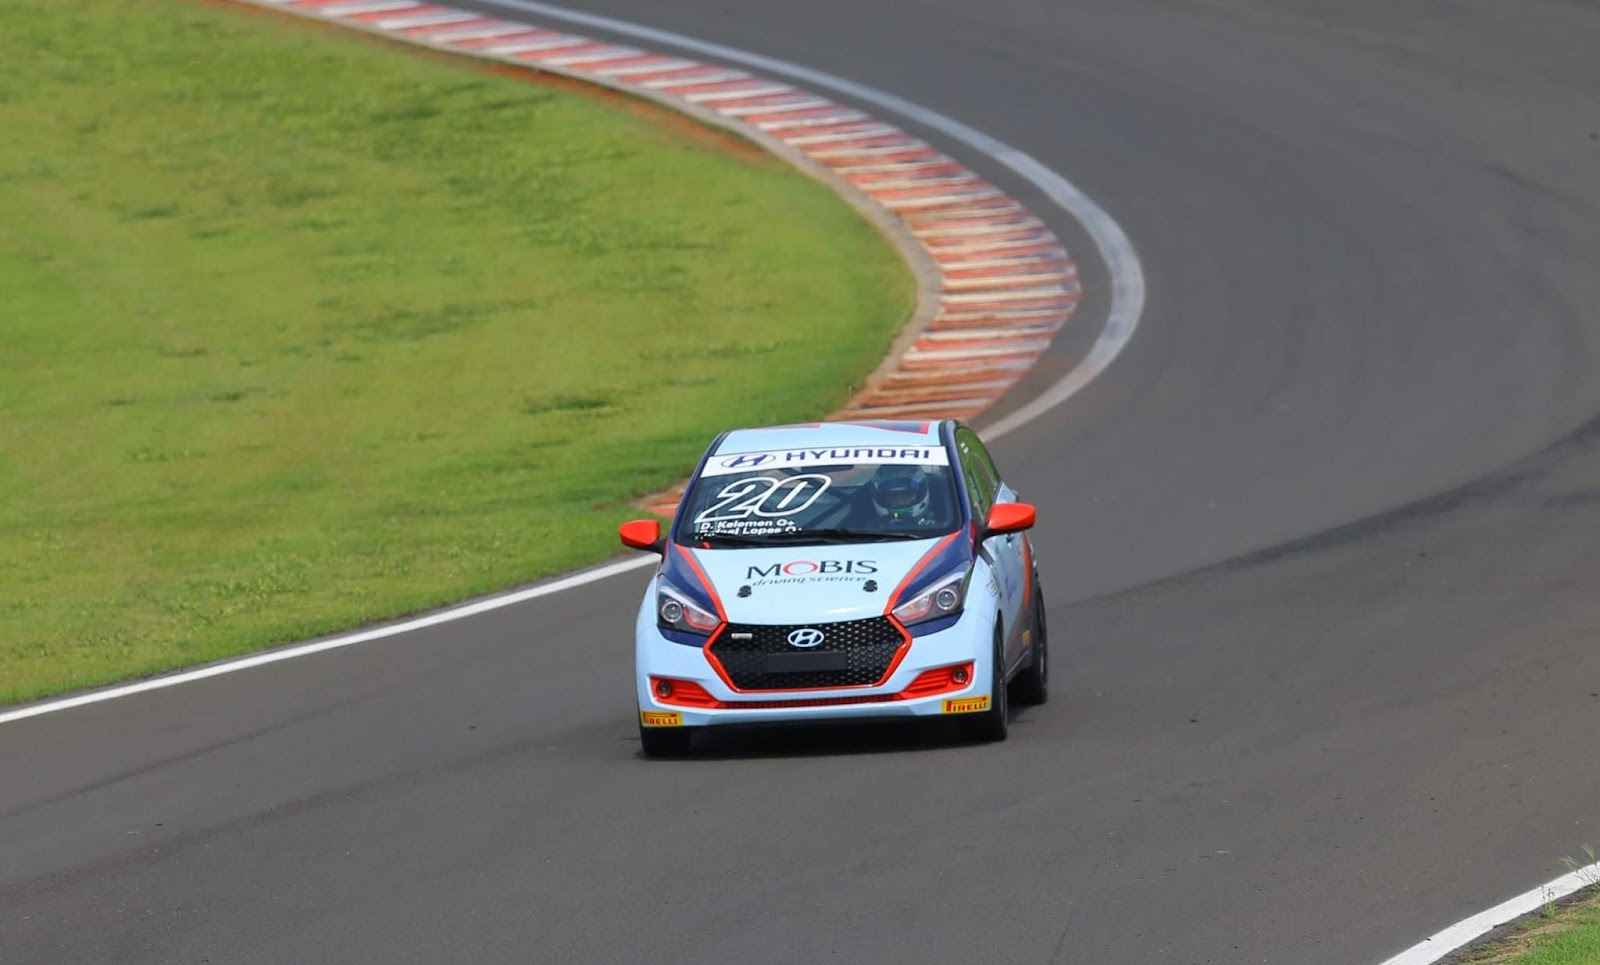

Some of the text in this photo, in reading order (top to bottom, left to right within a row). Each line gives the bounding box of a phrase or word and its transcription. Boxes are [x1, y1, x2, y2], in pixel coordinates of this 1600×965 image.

[786, 449, 930, 461] HYUNDAI
[694, 474, 832, 523] 20
[700, 522, 713, 530] D.
[717, 520, 773, 529] Kelemen
[742, 527, 782, 535] Lopes
[746, 560, 878, 579] MOBIS
[753, 577, 806, 586] driving
